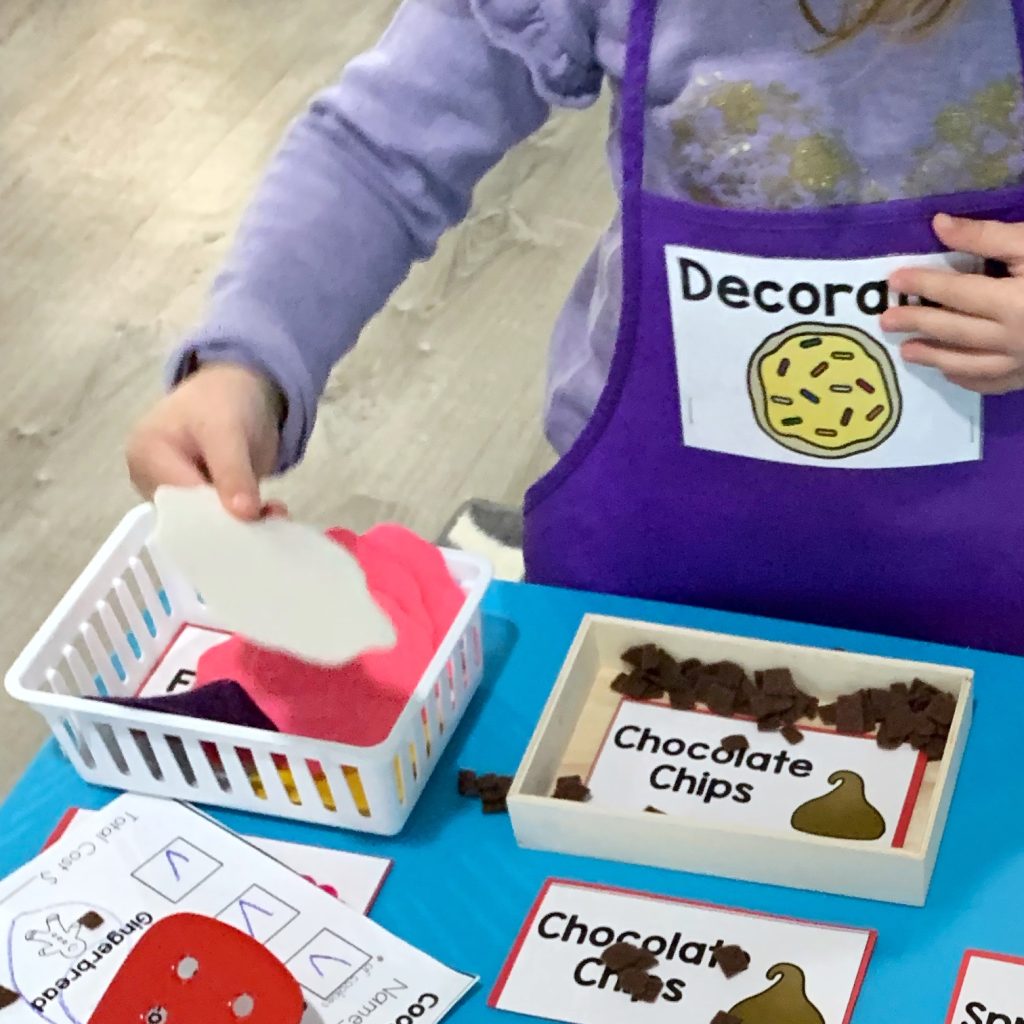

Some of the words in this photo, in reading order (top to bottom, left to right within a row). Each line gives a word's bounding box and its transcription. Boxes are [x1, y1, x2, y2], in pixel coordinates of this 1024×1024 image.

[677, 256, 942, 317] Decora
[614, 725, 813, 778] Chocolate
[650, 764, 754, 804] Chips
[95, 811, 139, 844] Total
[58, 841, 96, 871] Cost
[30, 911, 153, 1012] Gingerbread
[537, 911, 751, 968] Chocolat
[348, 978, 408, 1024] Name
[574, 957, 686, 1003] Chs
